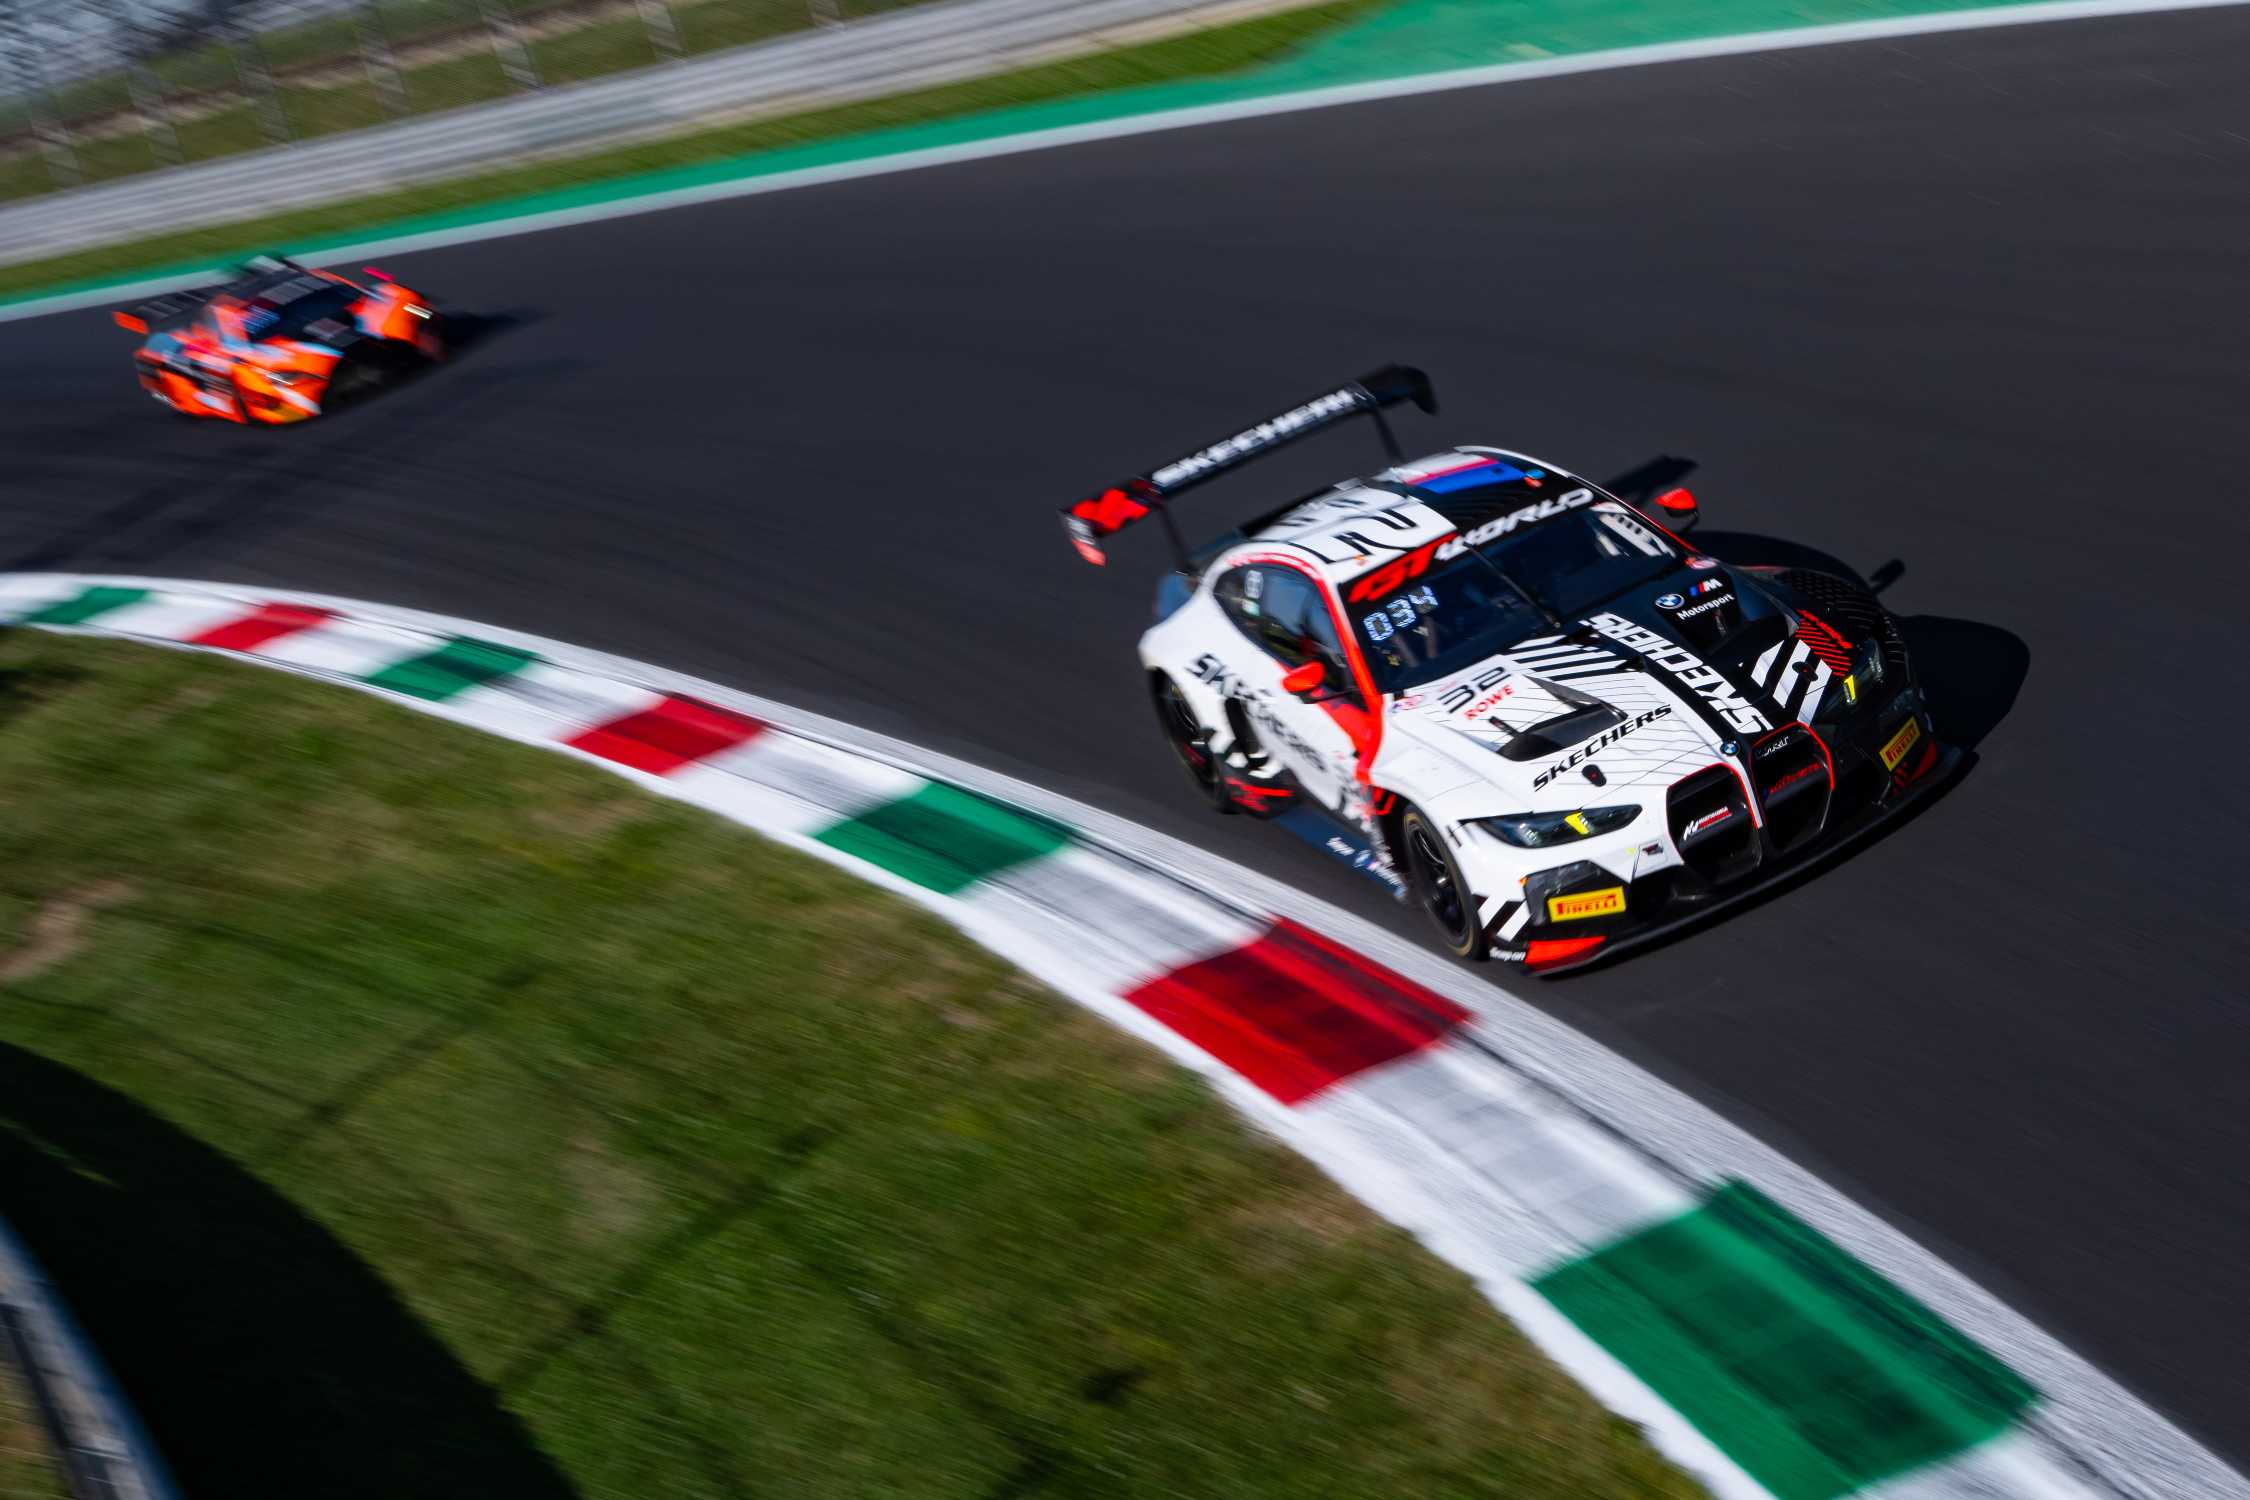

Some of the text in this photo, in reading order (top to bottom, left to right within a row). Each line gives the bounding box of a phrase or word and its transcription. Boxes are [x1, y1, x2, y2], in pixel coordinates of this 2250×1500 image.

[1433, 488, 1594, 561] WORLD
[1676, 593, 1735, 620] Motorsport
[1437, 666, 1512, 714] 32
[1579, 611, 1774, 734] SKECHERS
[1464, 684, 1514, 721] ROWE
[1534, 704, 1673, 792] SKECHERS
[1556, 894, 1617, 915] PIRELLI
